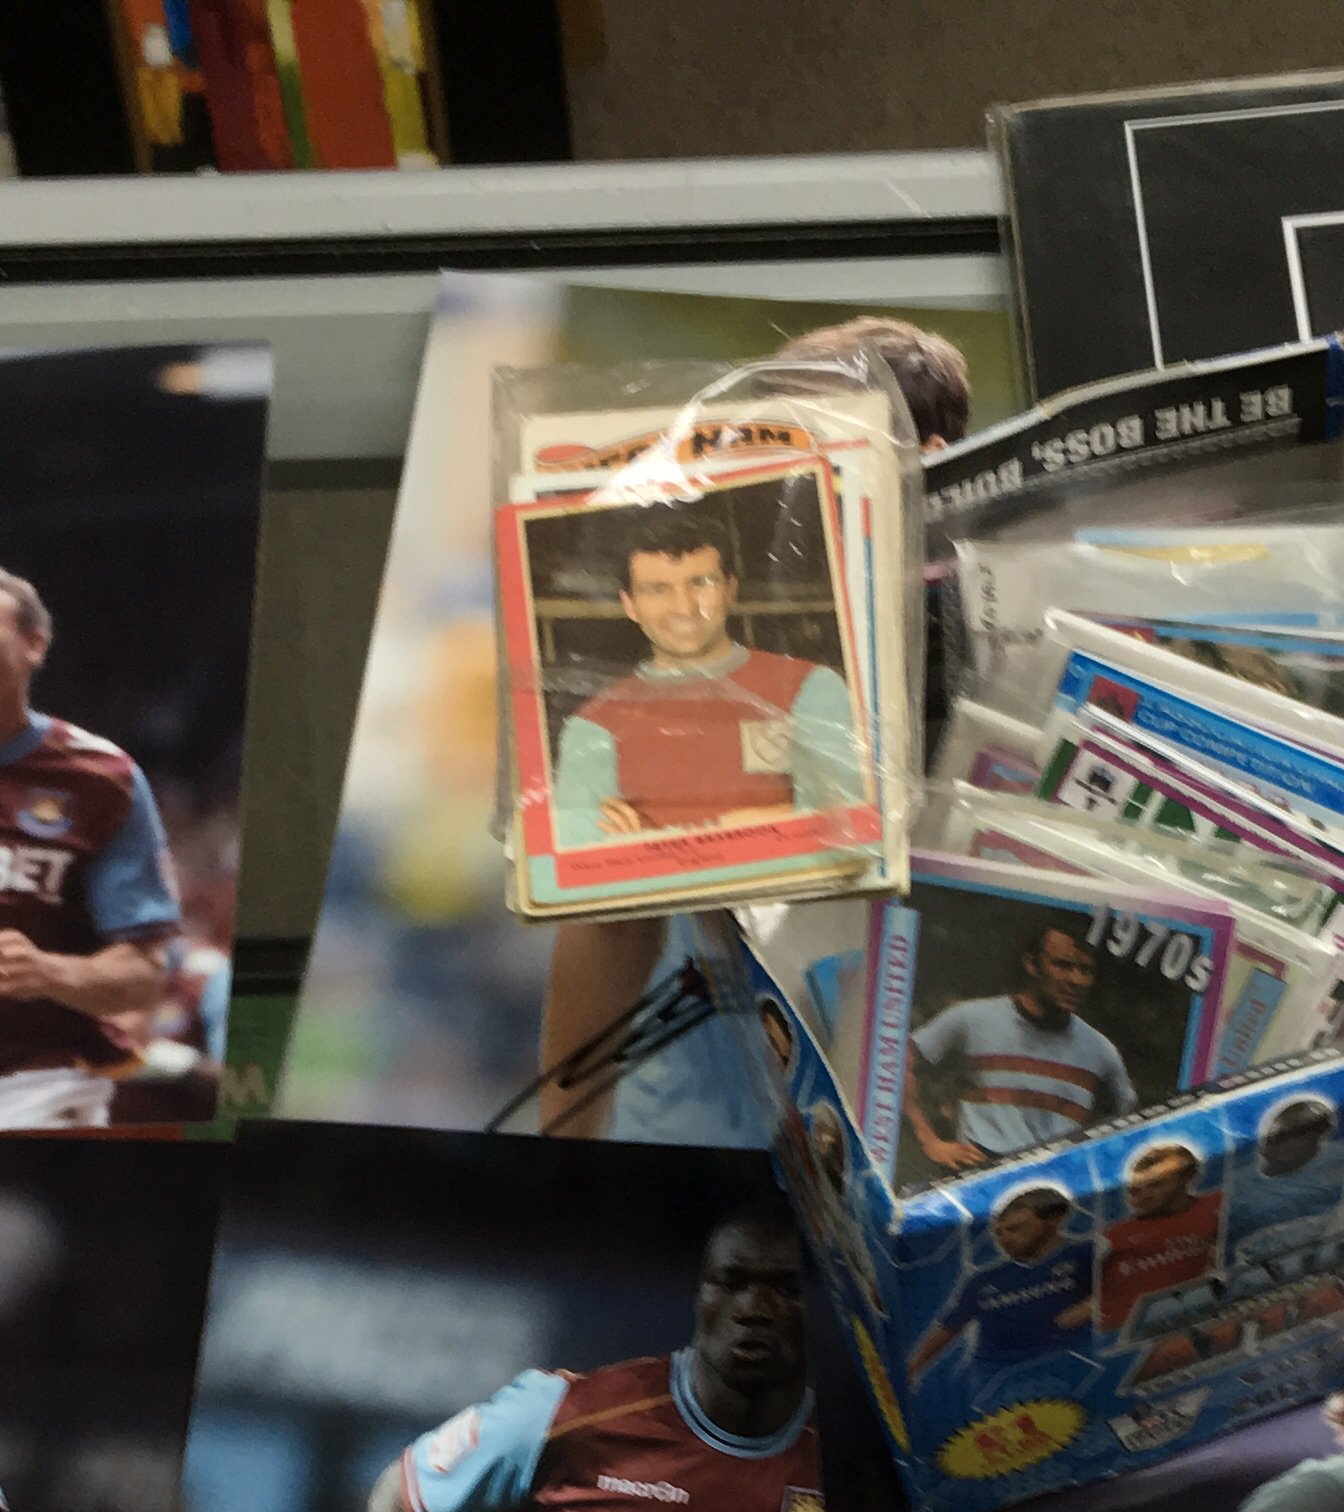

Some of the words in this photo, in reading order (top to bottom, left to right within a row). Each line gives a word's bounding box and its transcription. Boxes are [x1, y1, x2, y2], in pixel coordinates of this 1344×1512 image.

[1155, 396, 1232, 441] THE
[1239, 383, 1296, 423] BE
[1031, 414, 1146, 473] BOSS,
[1085, 902, 1216, 994] 1970s
[886, 934, 912, 1033] UNITED
[875, 1034, 903, 1090] HAM
[869, 1088, 899, 1163] WEST
